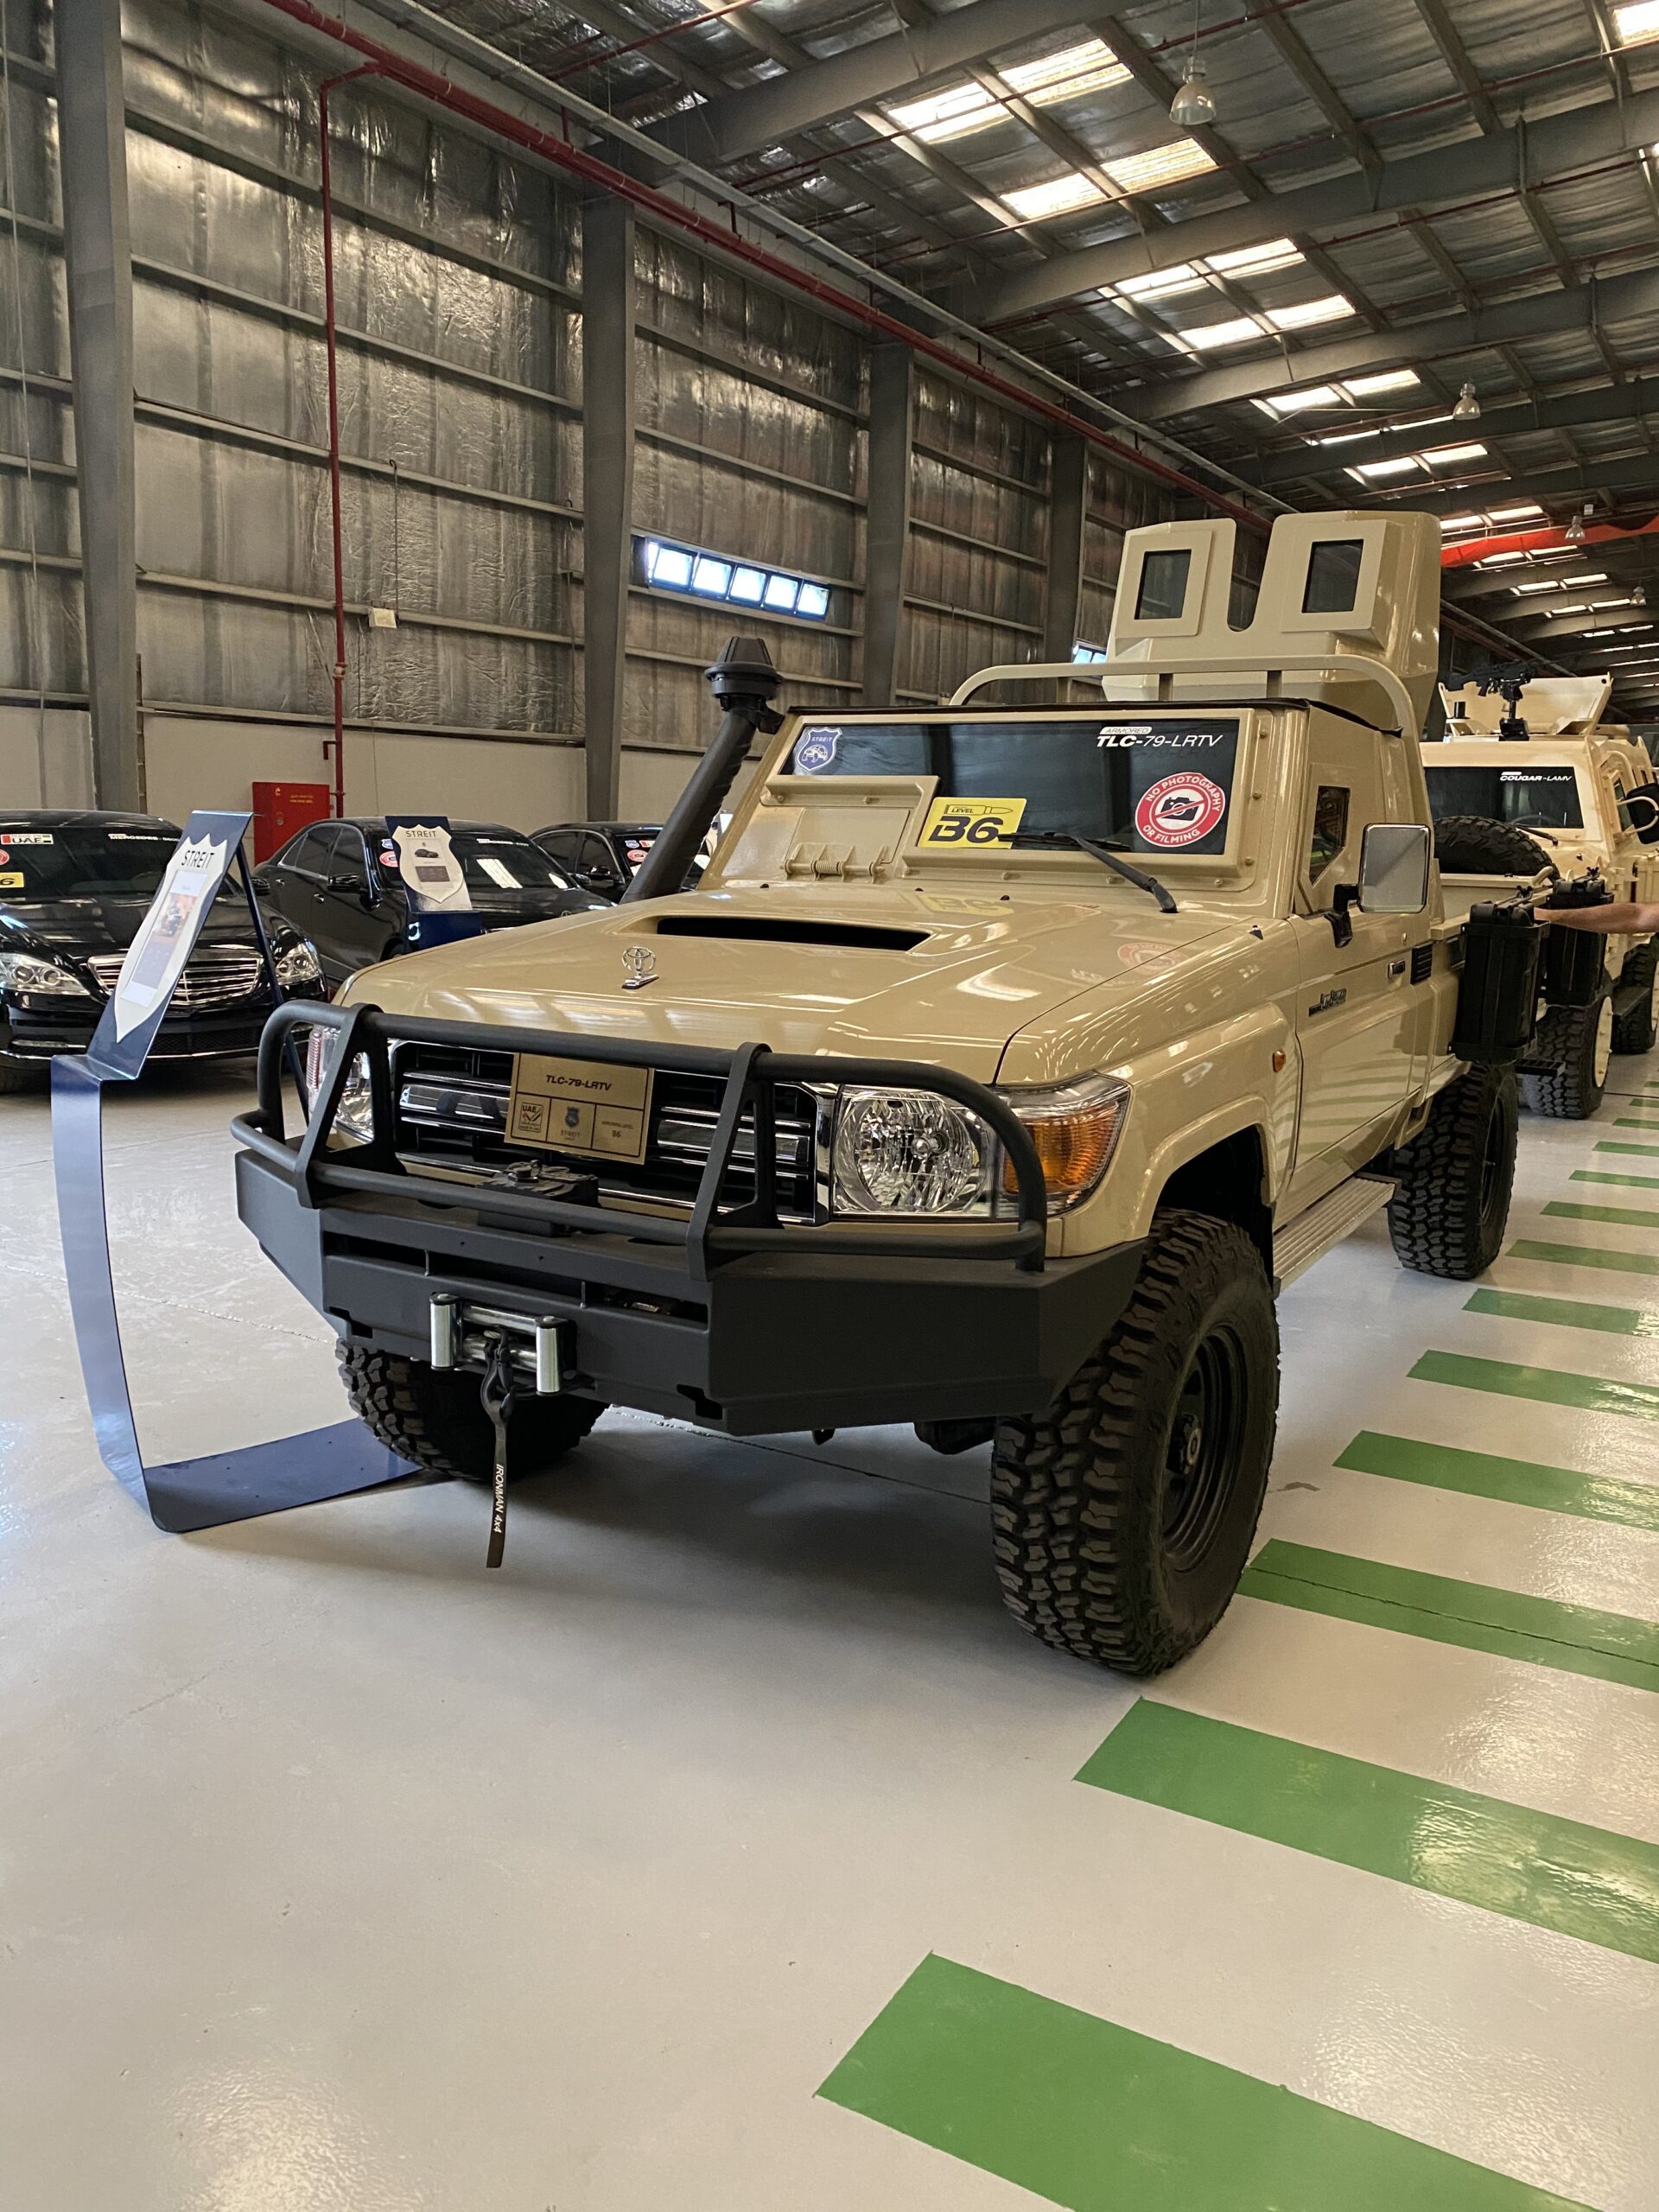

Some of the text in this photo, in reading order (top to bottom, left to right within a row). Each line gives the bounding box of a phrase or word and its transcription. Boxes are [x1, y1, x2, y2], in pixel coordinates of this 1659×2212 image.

[1096, 734, 1224, 747] TLC-79-LRTV
[1145, 775, 1222, 812] NO PHOTOGRAPHY
[928, 816, 1004, 843] B6
[1142, 824, 1201, 843] OR FILMING
[181, 850, 215, 869] STREIT
[545, 1074, 613, 1091] TLC-79-LRTV
[493, 1464, 505, 1534] IRONMAN 4x4
